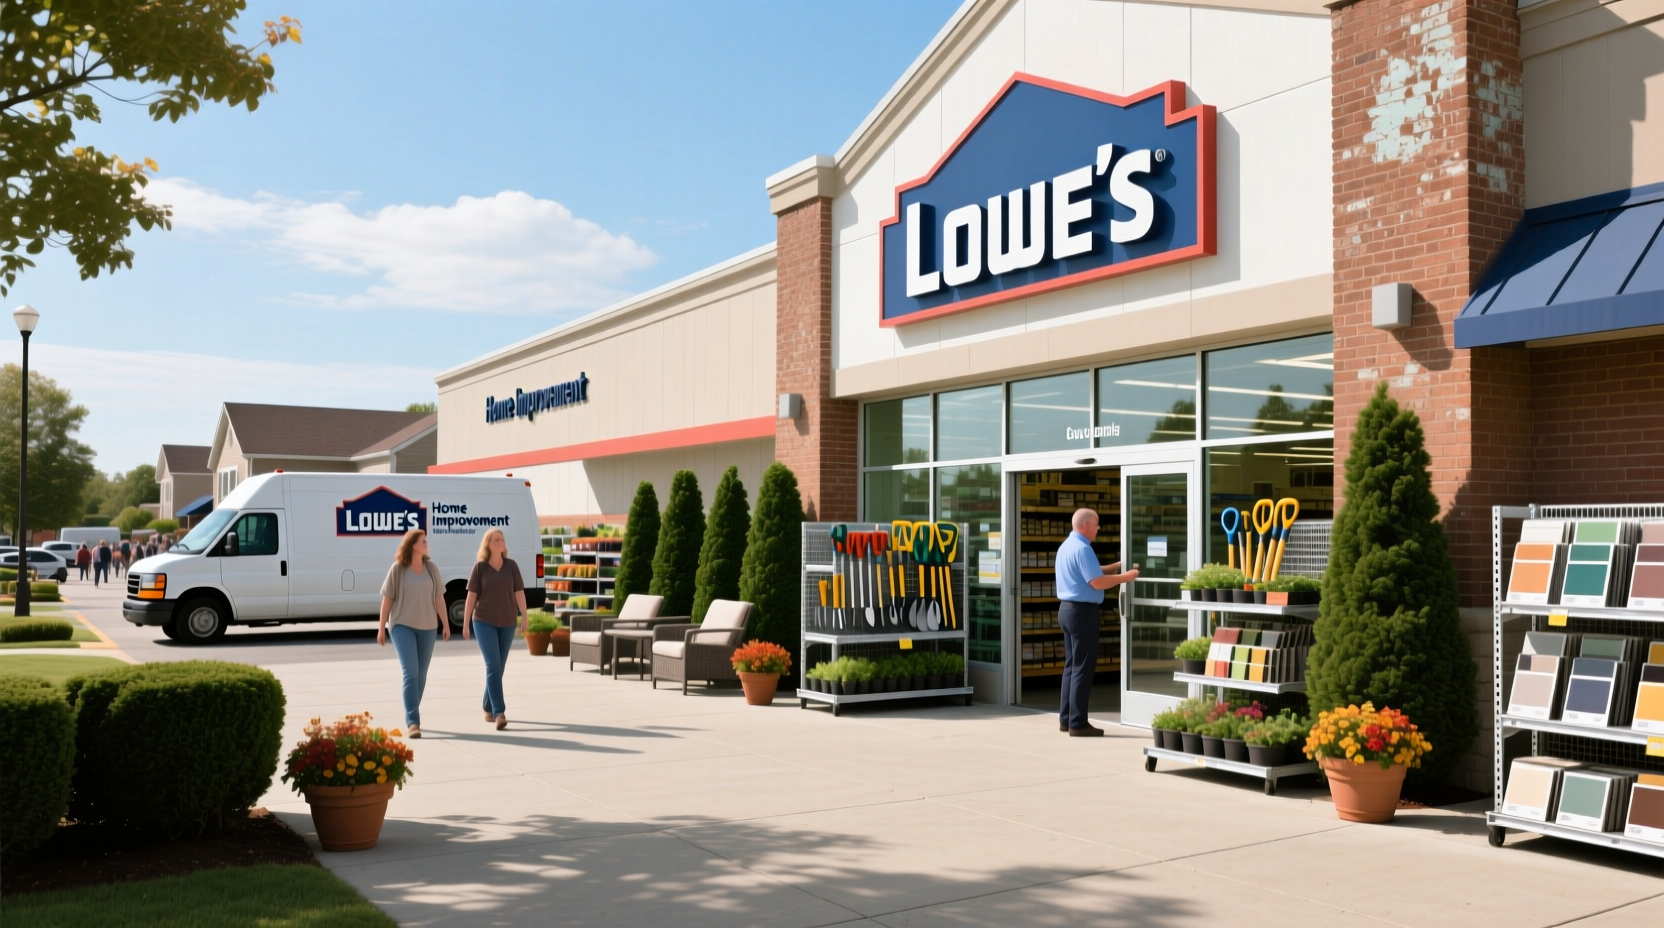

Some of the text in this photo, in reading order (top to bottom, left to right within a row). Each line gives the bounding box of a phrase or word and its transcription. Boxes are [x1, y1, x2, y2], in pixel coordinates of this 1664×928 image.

[907, 143, 1155, 297] LOWE'S
[432, 501, 467, 515] Home
[346, 509, 420, 532] LOWE'S
